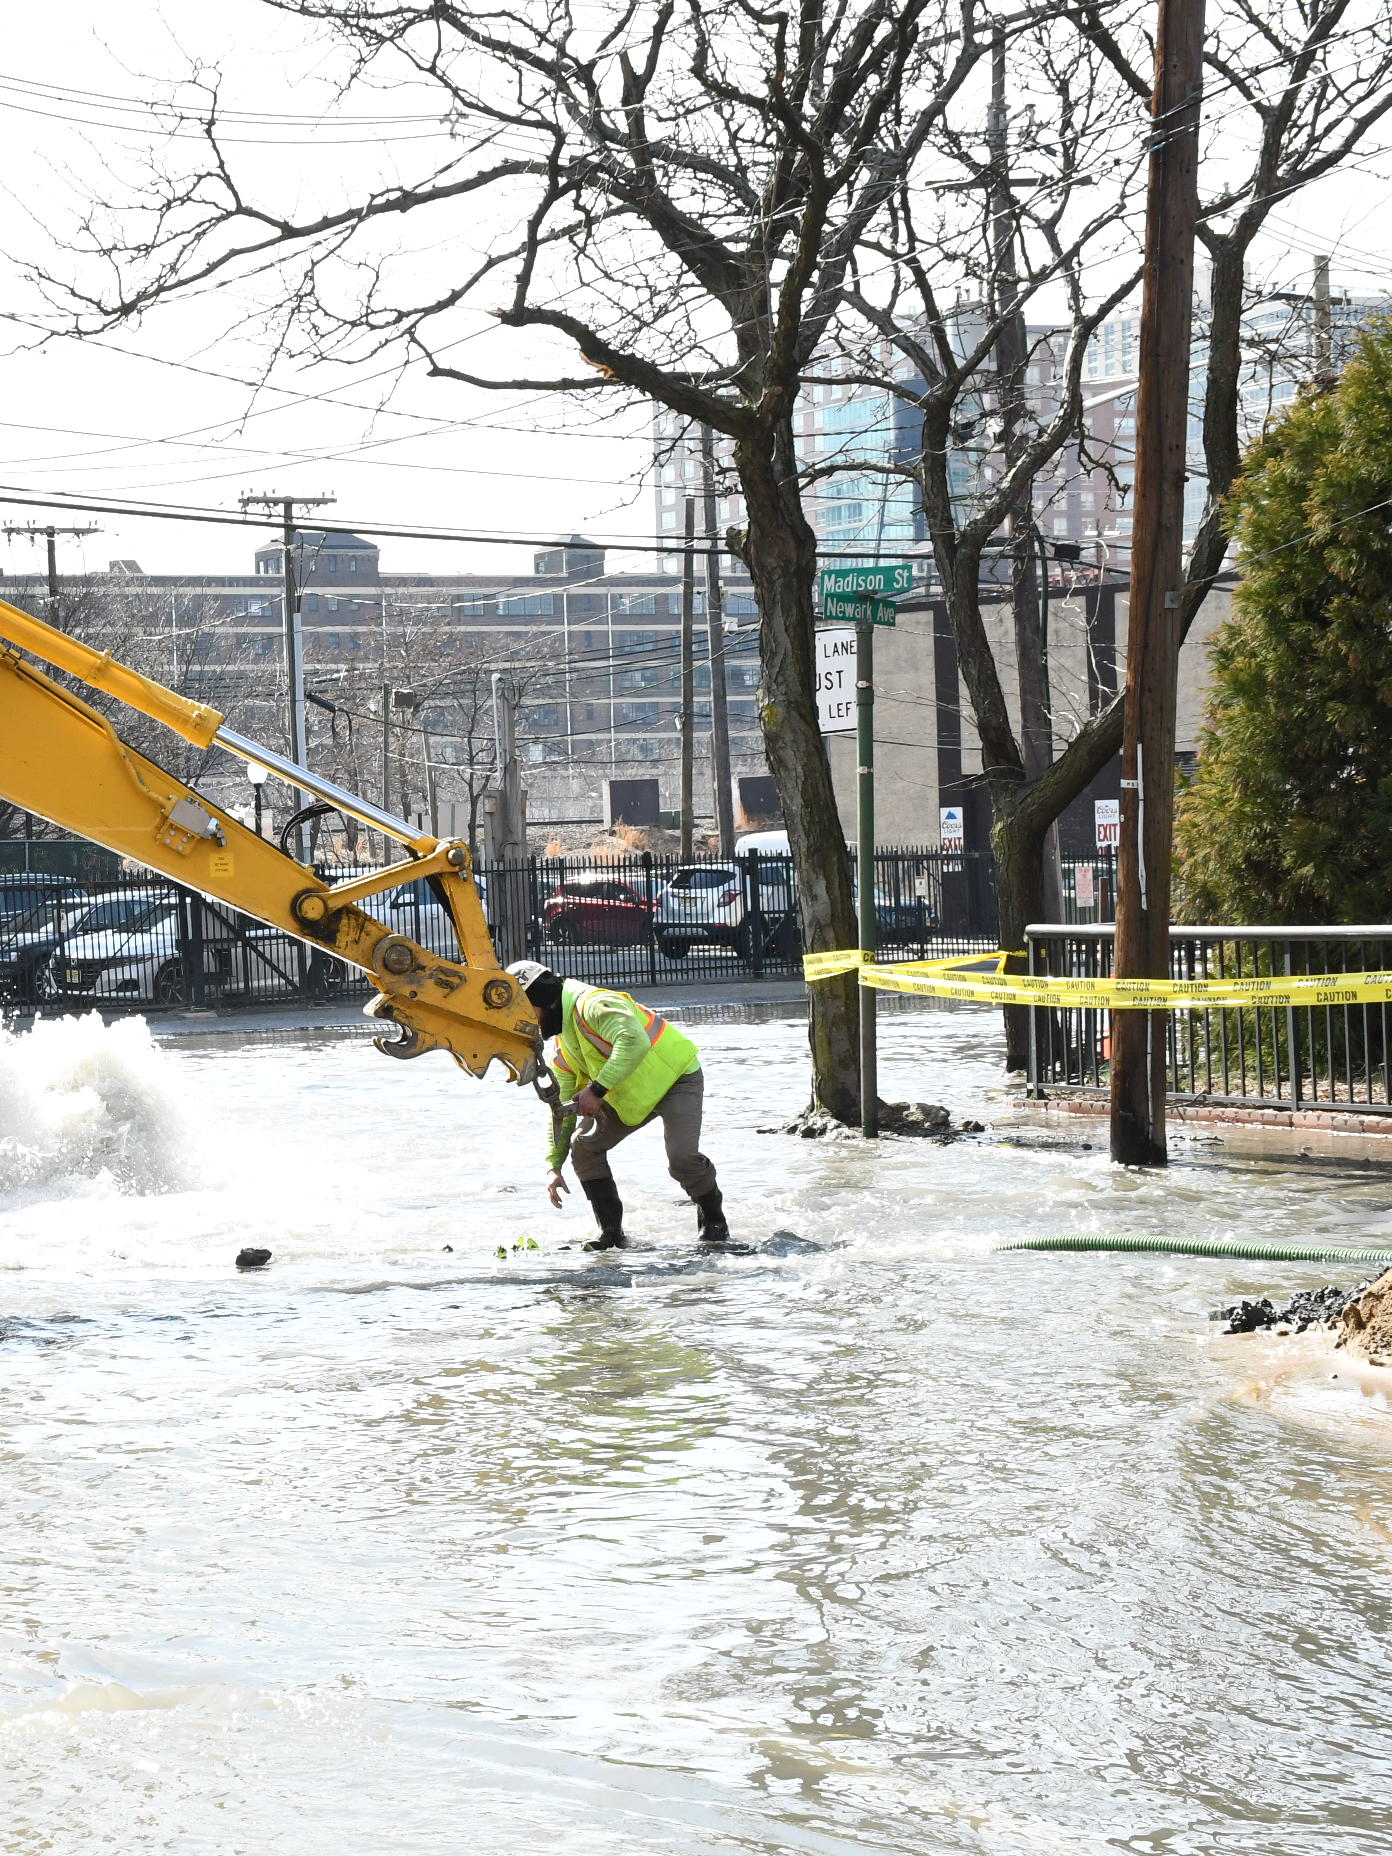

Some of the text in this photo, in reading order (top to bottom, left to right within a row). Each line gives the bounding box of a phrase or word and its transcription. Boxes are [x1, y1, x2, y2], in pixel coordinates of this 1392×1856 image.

[824, 569, 910, 593] Madison St
[827, 597, 895, 622] Newark Ave
[824, 640, 857, 658] LANE
[816, 670, 844, 691] UST
[829, 701, 857, 719] LEF
[1098, 824, 1118, 842] EXIT
[943, 837, 962, 851] EXIT
[982, 976, 1007, 986] CAUTION
[1022, 979, 1048, 989] CAUTION
[1066, 981, 1096, 990] CAUTION
[1116, 982, 1150, 992] CAUTION
[1173, 983, 1208, 993] CAUTION
[1233, 981, 1272, 992] CAUTION
[1364, 974, 1392, 985] CAUT
[913, 983, 936, 993] CAUTION
[951, 987, 975, 997] CAUTION
[991, 991, 1017, 1000] CAUTION
[1034, 994, 1061, 1004] CAUTION
[1080, 996, 1110, 1006] CAUTION
[1132, 996, 1168, 1006] CAUTION
[1251, 995, 1290, 1005] CAUTION
[1316, 991, 1358, 1002] CAUTION
